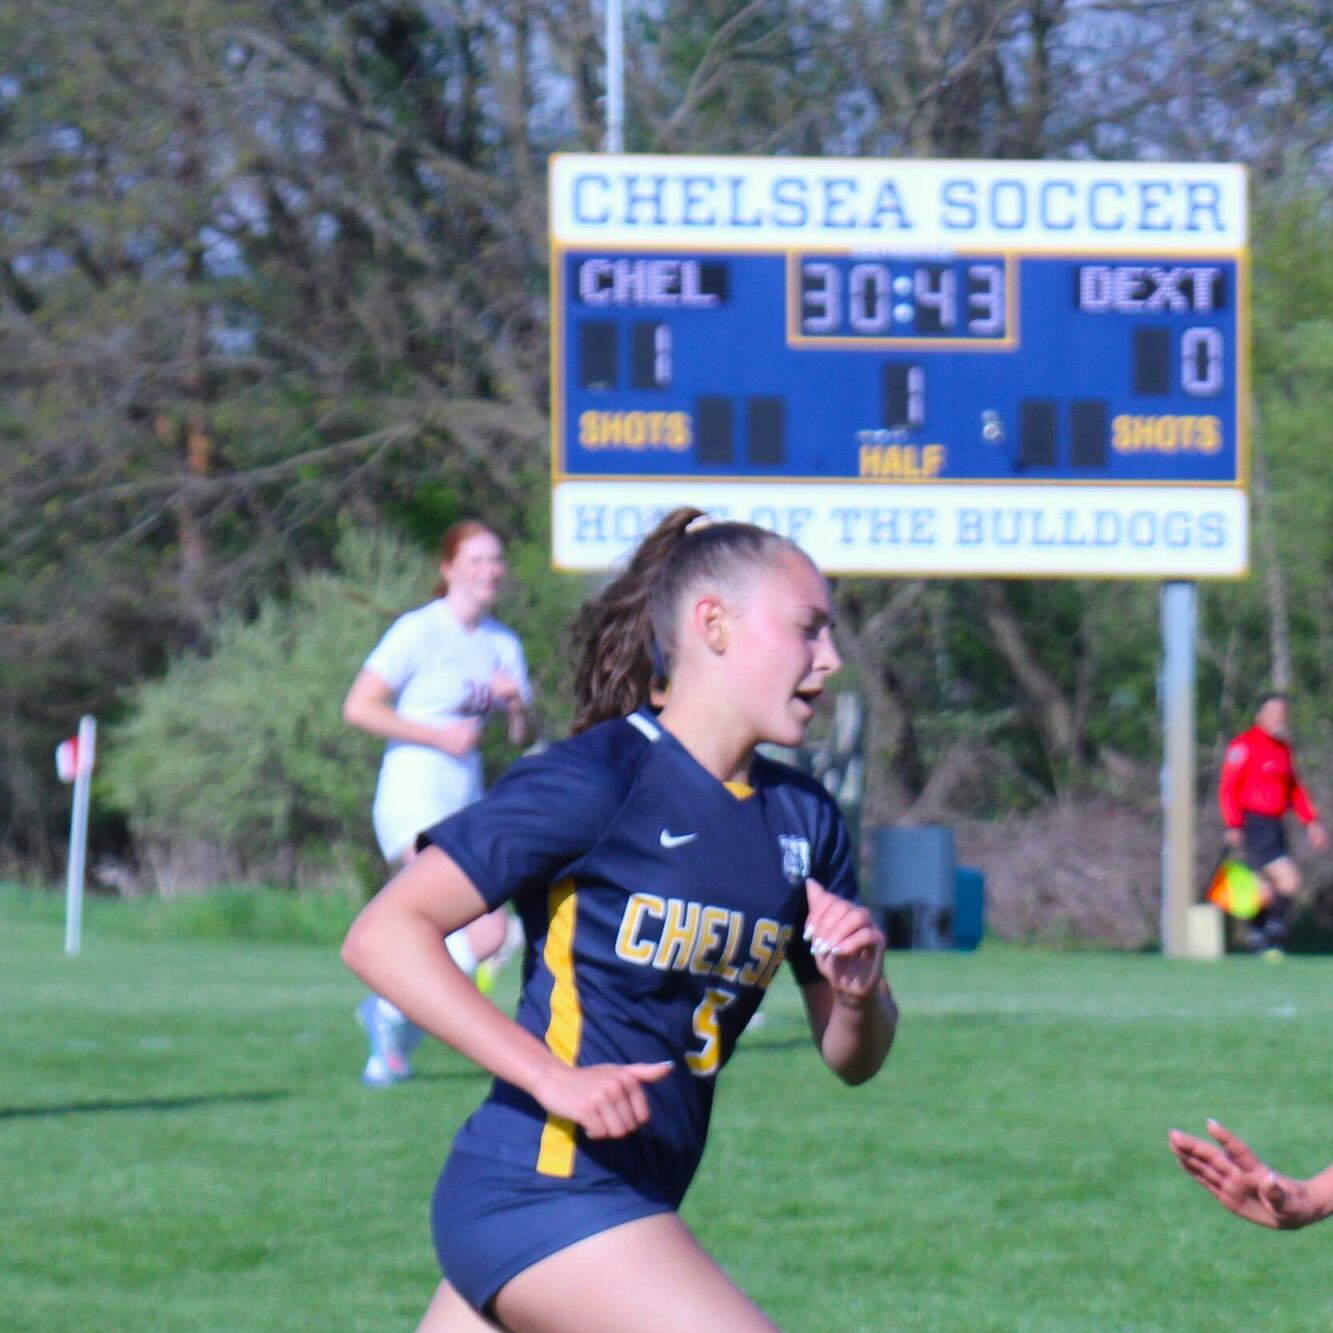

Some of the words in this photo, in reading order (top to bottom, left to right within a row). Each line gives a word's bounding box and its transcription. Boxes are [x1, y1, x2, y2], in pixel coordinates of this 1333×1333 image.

[571, 174, 913, 229] CHELSEA
[940, 178, 1227, 232] SOCCER
[578, 259, 721, 308] CHEL
[802, 262, 1005, 334] 30:43
[1079, 265, 1222, 314] DEXT
[1180, 326, 1225, 396] 0
[579, 410, 692, 451] SHOTS
[1112, 414, 1223, 454] SHOTS
[859, 443, 946, 477] HALF
[574, 504, 728, 542] HO
[832, 507, 936, 546] THE
[955, 508, 1227, 549] BULLDOGS
[684, 986, 738, 1077] 5
